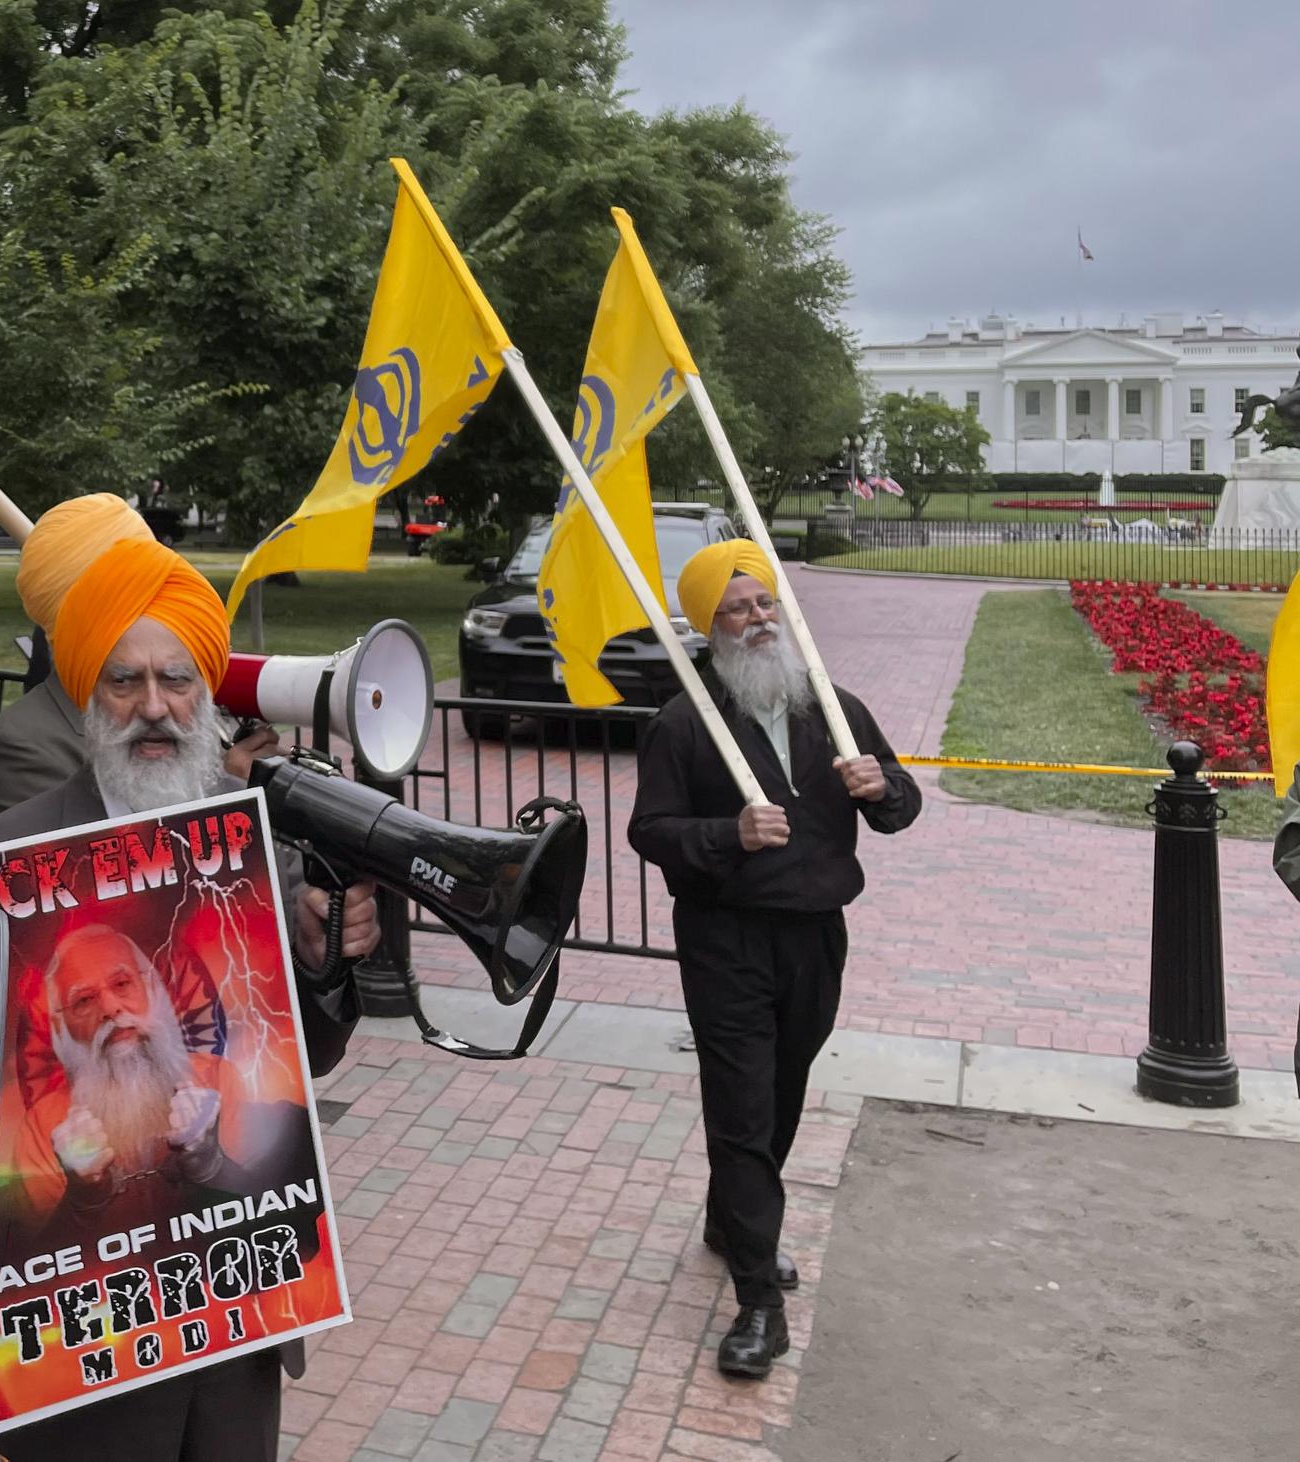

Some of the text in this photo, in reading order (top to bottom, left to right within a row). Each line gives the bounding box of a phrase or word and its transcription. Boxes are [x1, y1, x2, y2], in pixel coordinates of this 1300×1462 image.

[90, 826, 178, 900] EM
[187, 811, 252, 875] UP
[410, 856, 458, 894] PYLE
[97, 1223, 156, 1262] OF
[169, 1178, 318, 1242] INDIAN
[0, 1224, 305, 1365] TERROR
